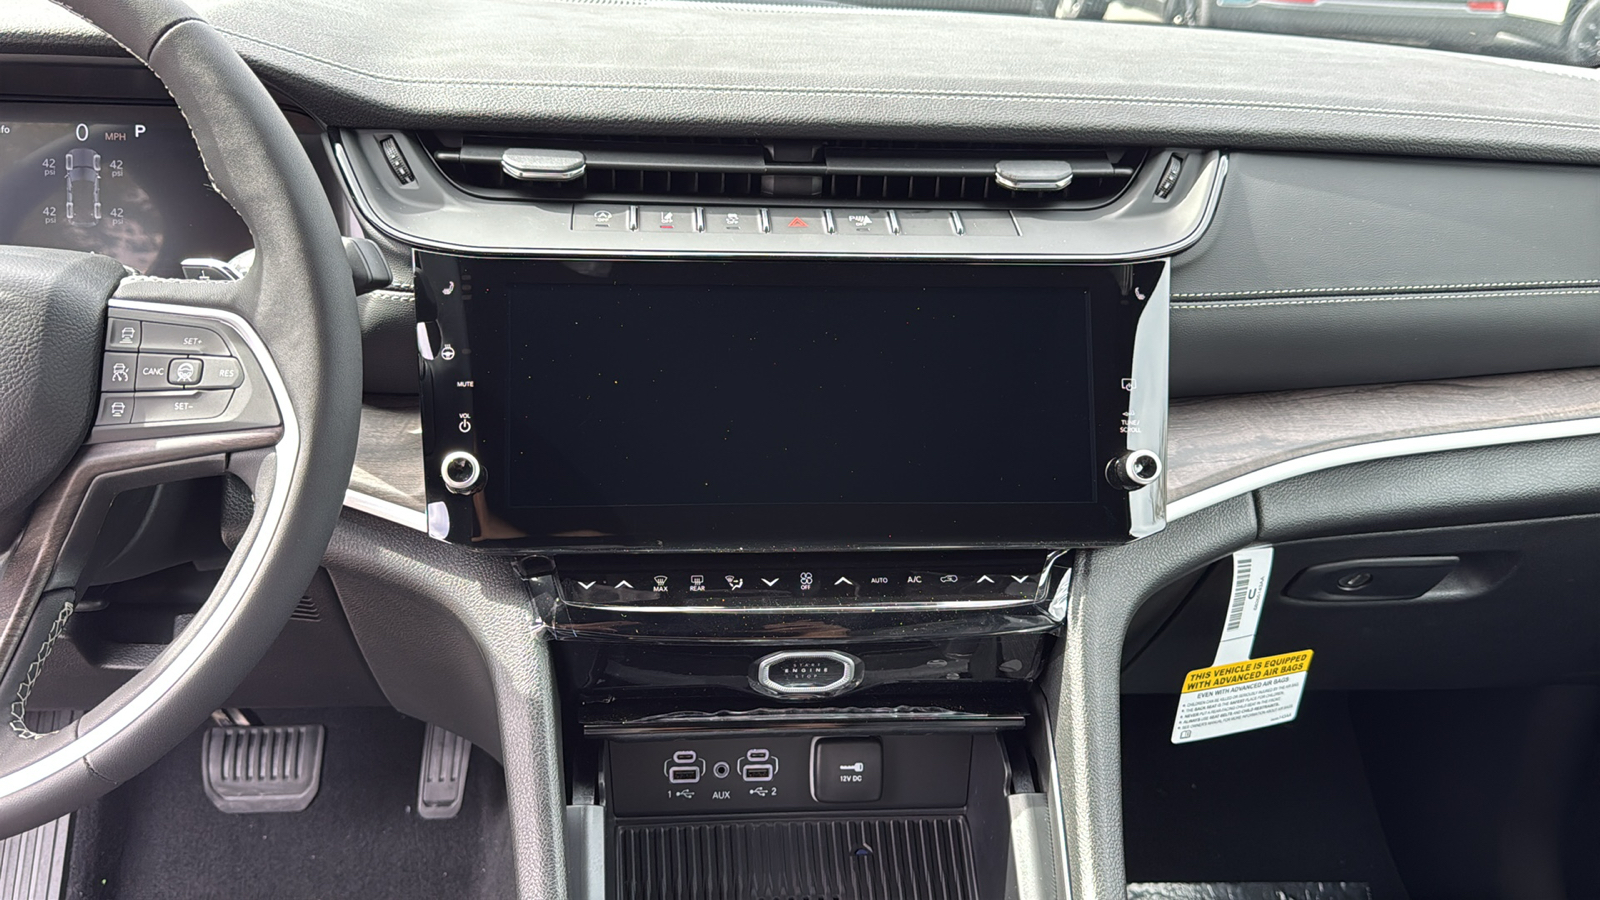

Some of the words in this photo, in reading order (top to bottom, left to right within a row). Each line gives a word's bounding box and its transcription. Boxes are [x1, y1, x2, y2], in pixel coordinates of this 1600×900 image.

[75, 123, 88, 141] 0
[104, 132, 127, 141] MPH
[135, 124, 146, 138] P
[42, 159, 56, 168] 42
[110, 160, 124, 169] 42
[44, 168, 56, 176] psi
[112, 169, 124, 177] psi
[43, 207, 57, 216] 42
[110, 208, 124, 217] 42
[45, 216, 57, 224] psi
[112, 217, 124, 225] psi
[143, 367, 164, 376] CANC
[219, 369, 234, 377] RES
[907, 575, 922, 583] A/C
[1190, 672, 1212, 681] THIS
[1214, 664, 1252, 677] VEHICLE
[1265, 654, 1307, 667] EQUIPPED
[1187, 680, 1211, 691] WITH
[1213, 671, 1262, 686] ADVANCED
[1264, 668, 1279, 676] AIR
[1281, 663, 1304, 673] BAGS
[1197, 691, 1214, 699] EVEN
[1230, 682, 1263, 692] ADVANCED
[712, 791, 730, 799] AUX
[771, 787, 777, 795] 2
